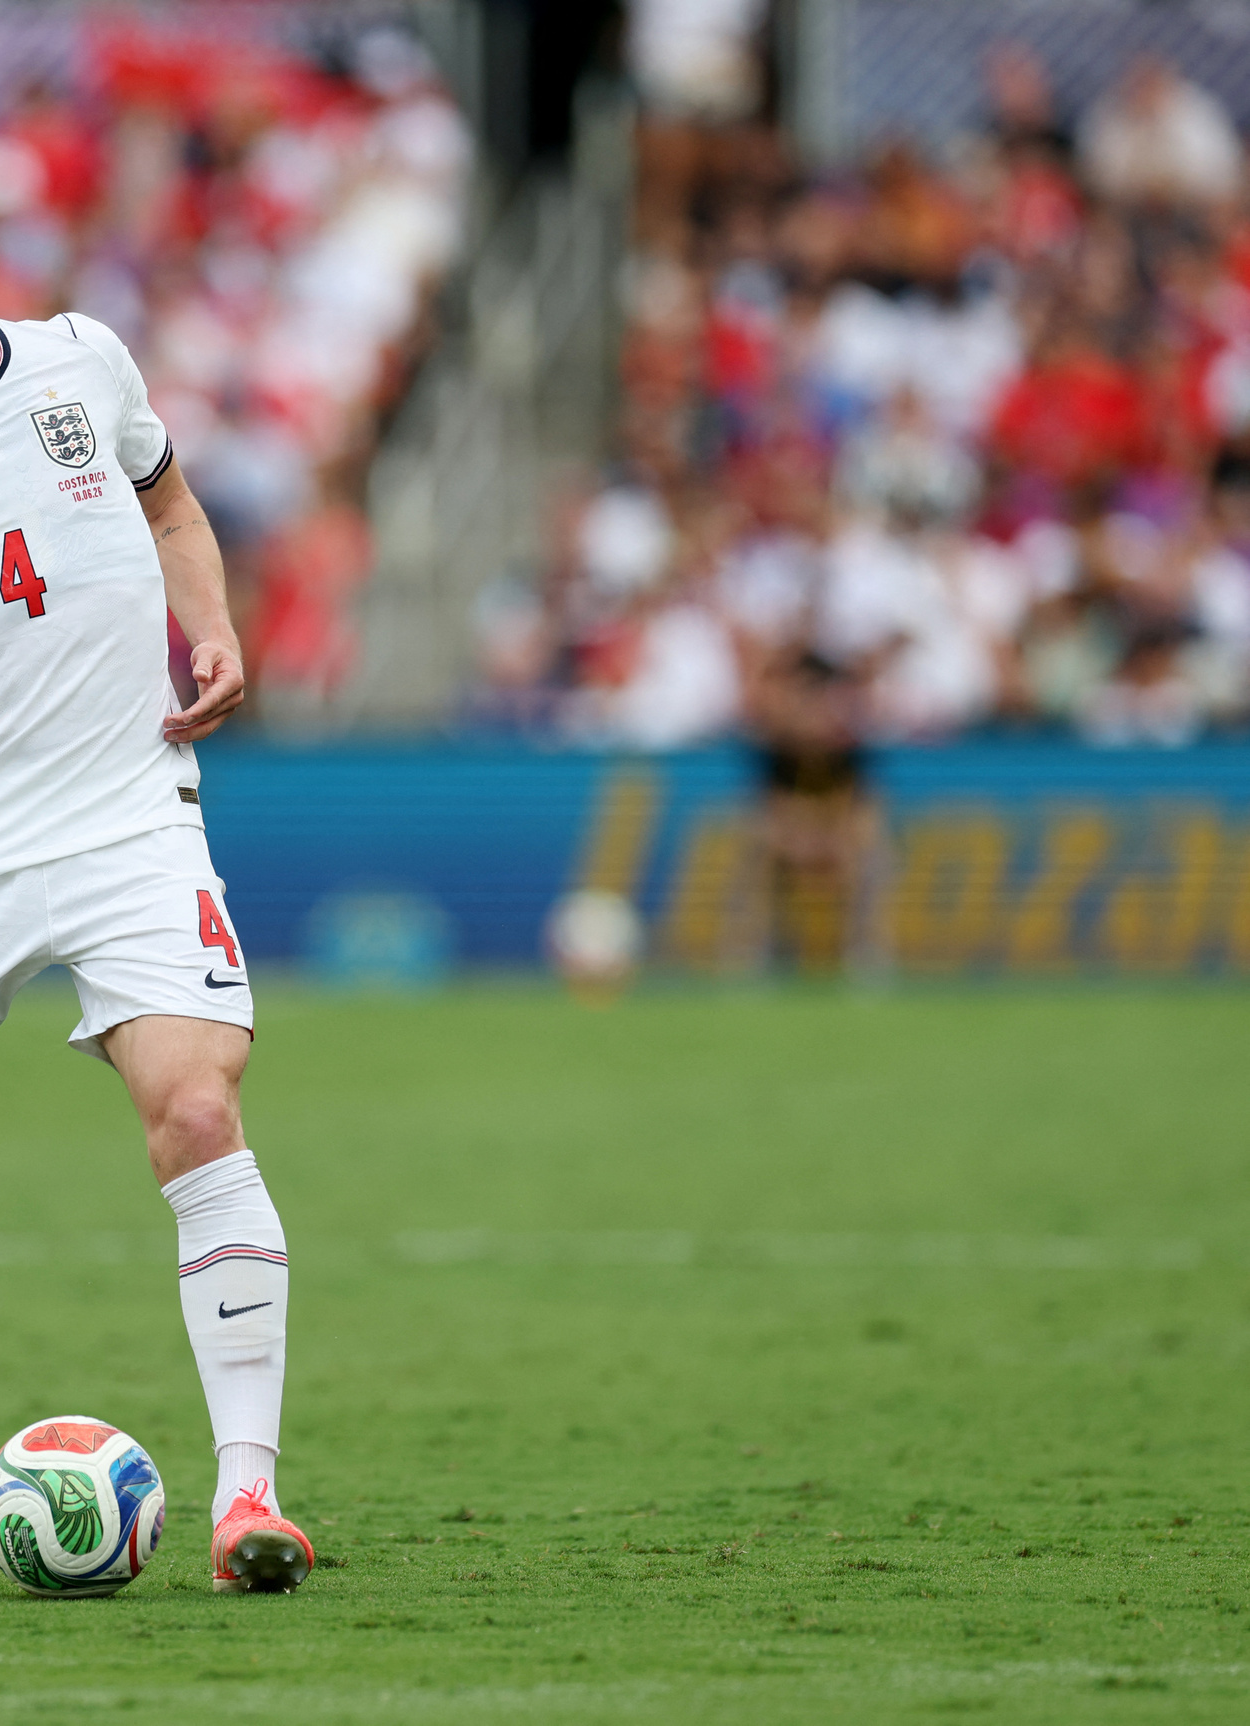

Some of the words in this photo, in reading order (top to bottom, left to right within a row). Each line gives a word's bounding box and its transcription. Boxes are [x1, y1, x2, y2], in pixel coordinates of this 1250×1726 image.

[58, 475, 88, 492] COSTA
[89, 471, 107, 484] RICA
[72, 486, 103, 503] 10.06.26
[0, 528, 47, 619] 4
[196, 889, 240, 968] 4
